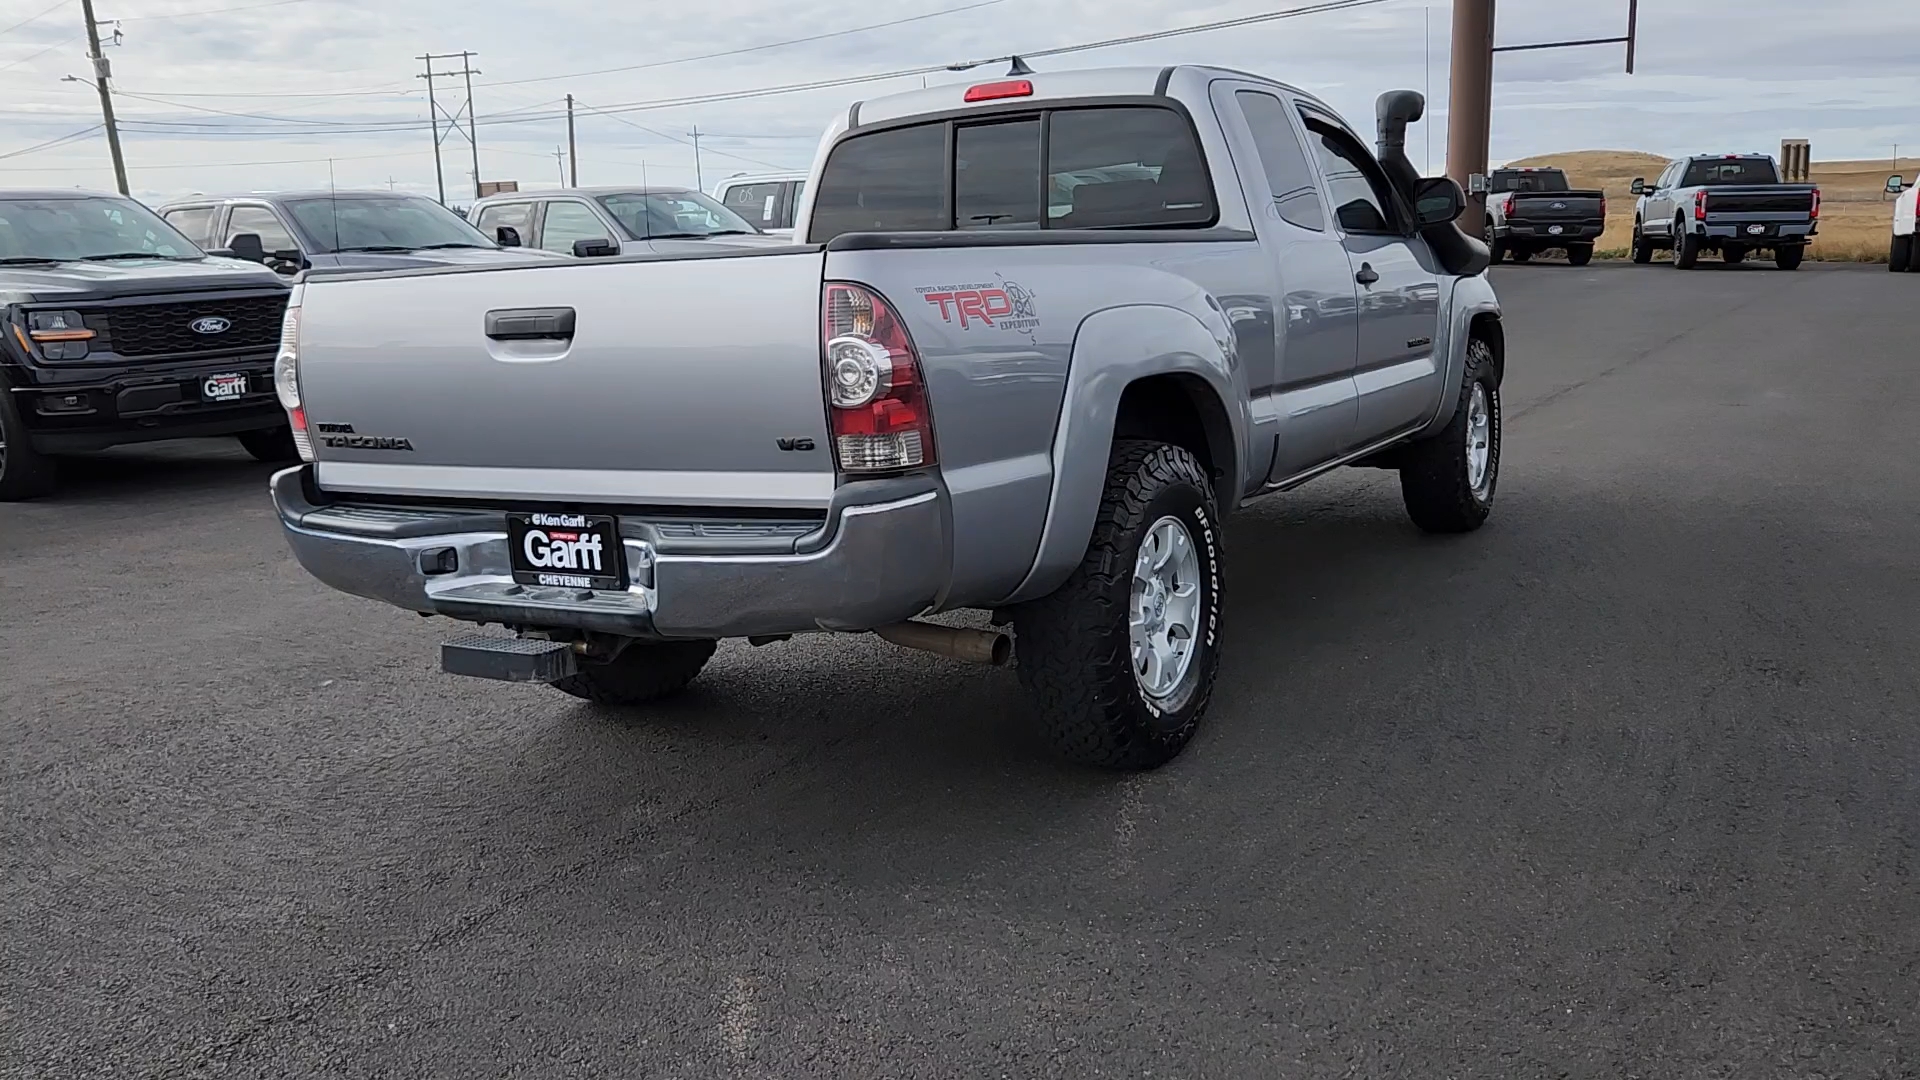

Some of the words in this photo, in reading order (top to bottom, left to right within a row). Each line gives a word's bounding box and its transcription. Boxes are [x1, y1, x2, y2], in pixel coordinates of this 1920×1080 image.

[914, 285, 937, 294] TOYOTA
[936, 284, 959, 292] RACING
[958, 282, 995, 291] DEVELOPMENT
[924, 288, 1013, 331] TRD
[199, 320, 224, 332] Ford
[999, 318, 1041, 331] EXPEDITION
[204, 377, 246, 397] Garff
[319, 435, 414, 452] TACOMA
[775, 437, 815, 452] V6
[541, 513, 561, 527] Ken
[560, 514, 585, 528] Garff
[524, 529, 602, 571] Garff
[538, 574, 591, 588] CHEYENNE
[1194, 507, 1220, 647] BFGoodrich
